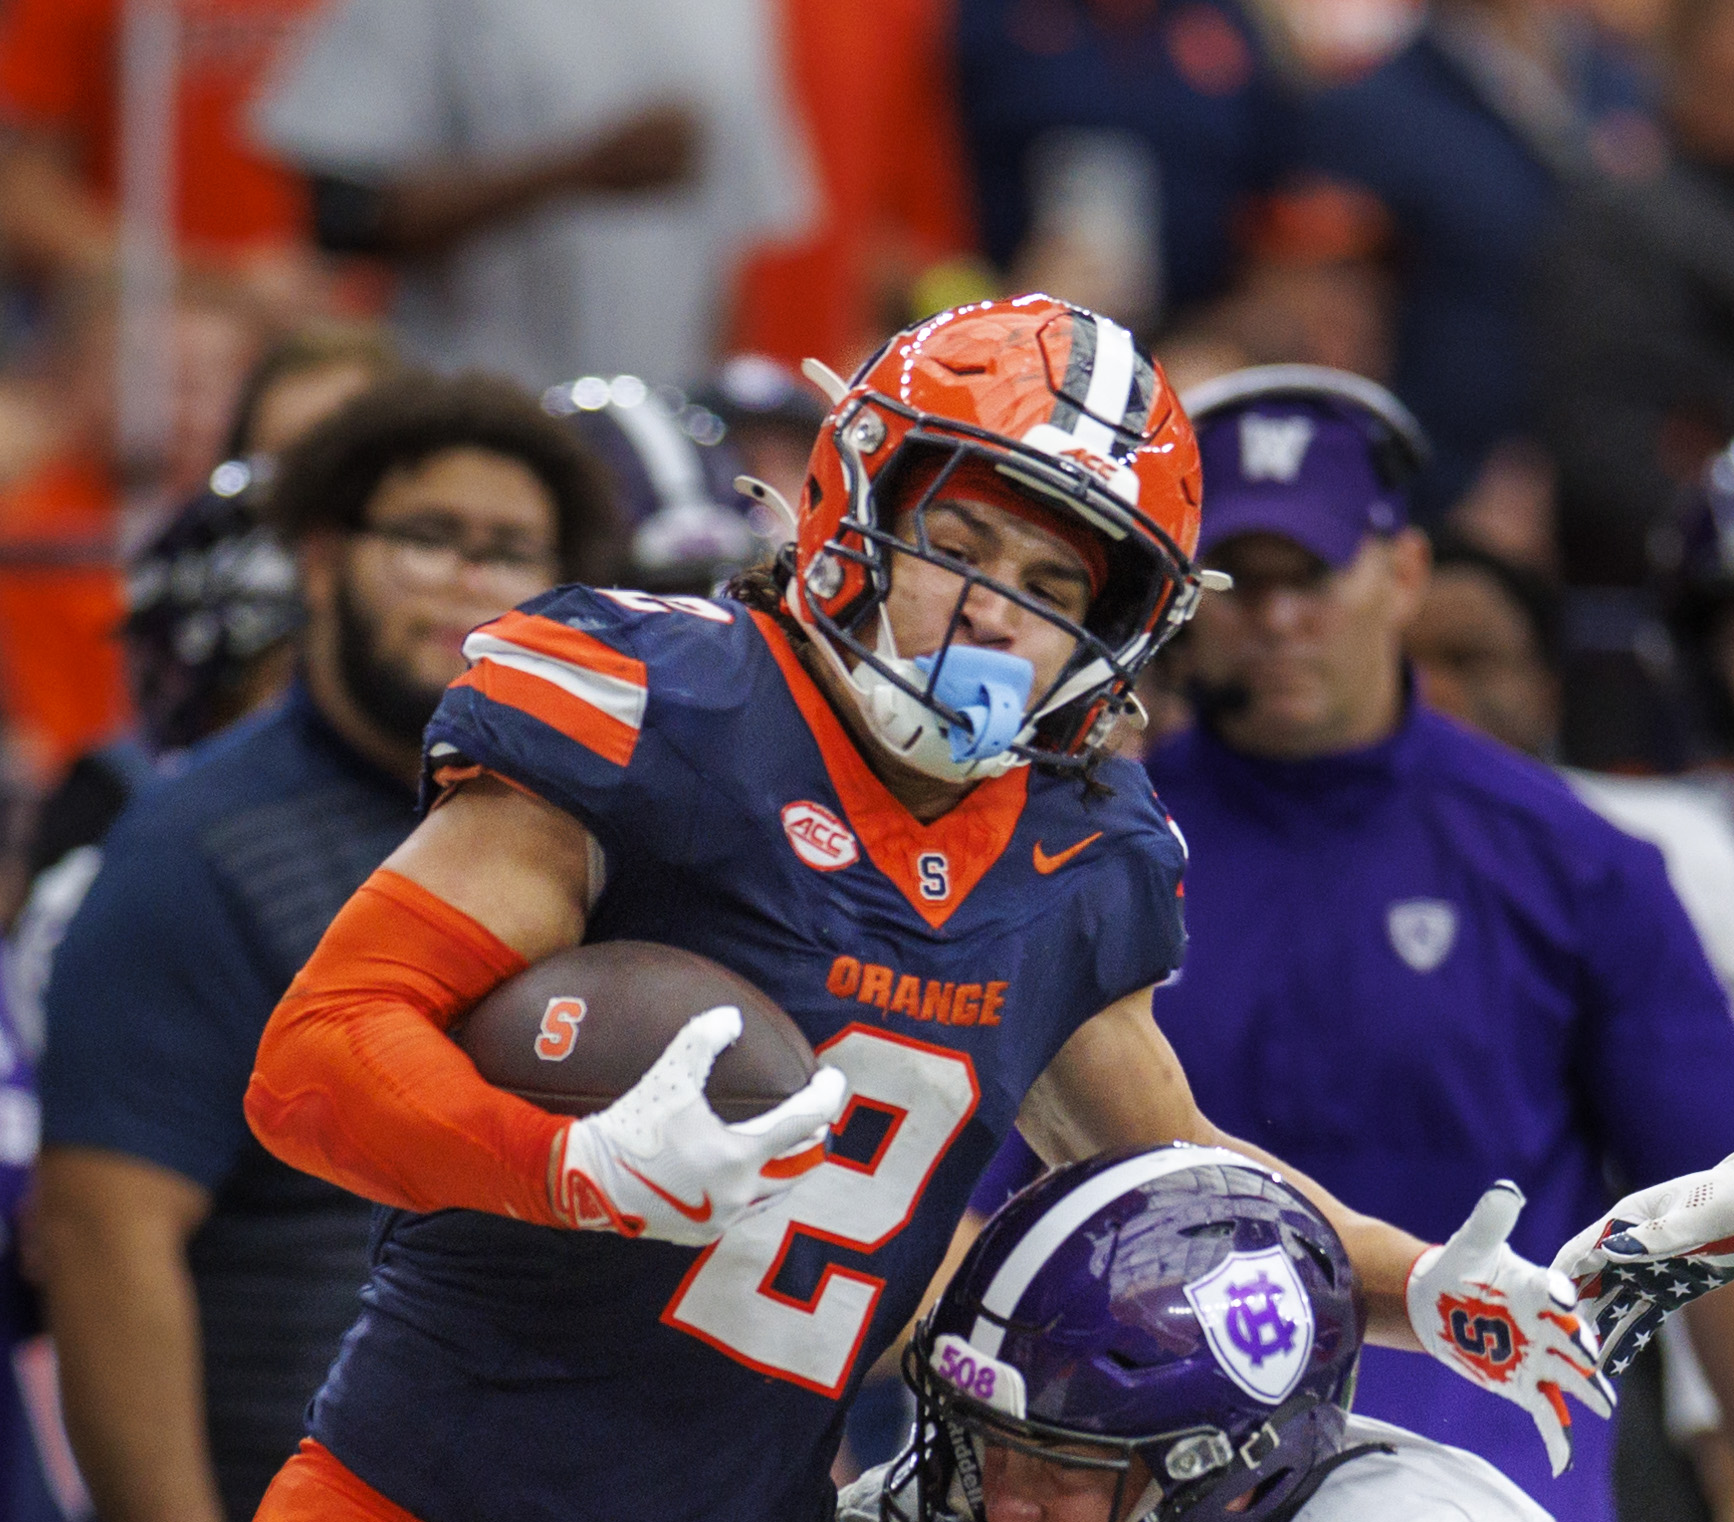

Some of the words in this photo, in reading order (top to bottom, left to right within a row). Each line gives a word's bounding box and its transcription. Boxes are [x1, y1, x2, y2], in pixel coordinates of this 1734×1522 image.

[1058, 448, 1118, 482] ACC
[785, 816, 849, 859] ACC
[917, 853, 950, 901] S
[826, 955, 1009, 1027] ORANGE
[534, 996, 588, 1062] S
[659, 1020, 982, 1401] 2
[938, 1344, 996, 1399] 508
